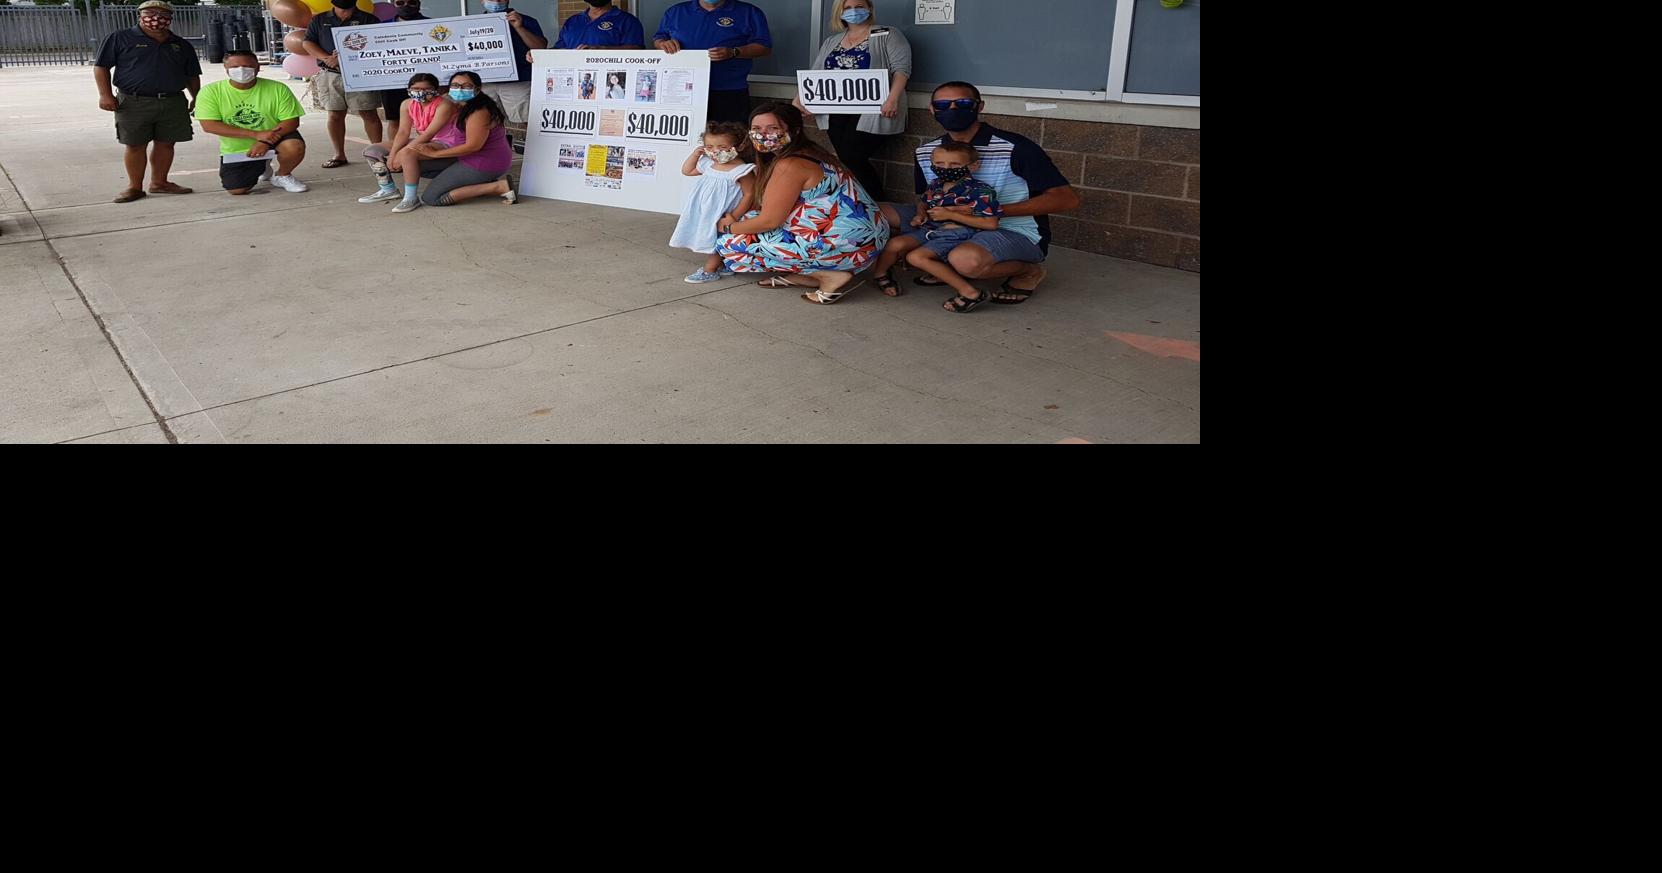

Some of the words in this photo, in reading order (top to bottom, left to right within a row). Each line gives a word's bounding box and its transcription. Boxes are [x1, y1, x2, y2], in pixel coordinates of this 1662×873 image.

[467, 40, 504, 51] $40,000
[624, 57, 662, 65] COOK-OFF
[803, 77, 881, 103] $40,000
[541, 108, 596, 131] $40,000
[627, 112, 689, 137] $40,000
